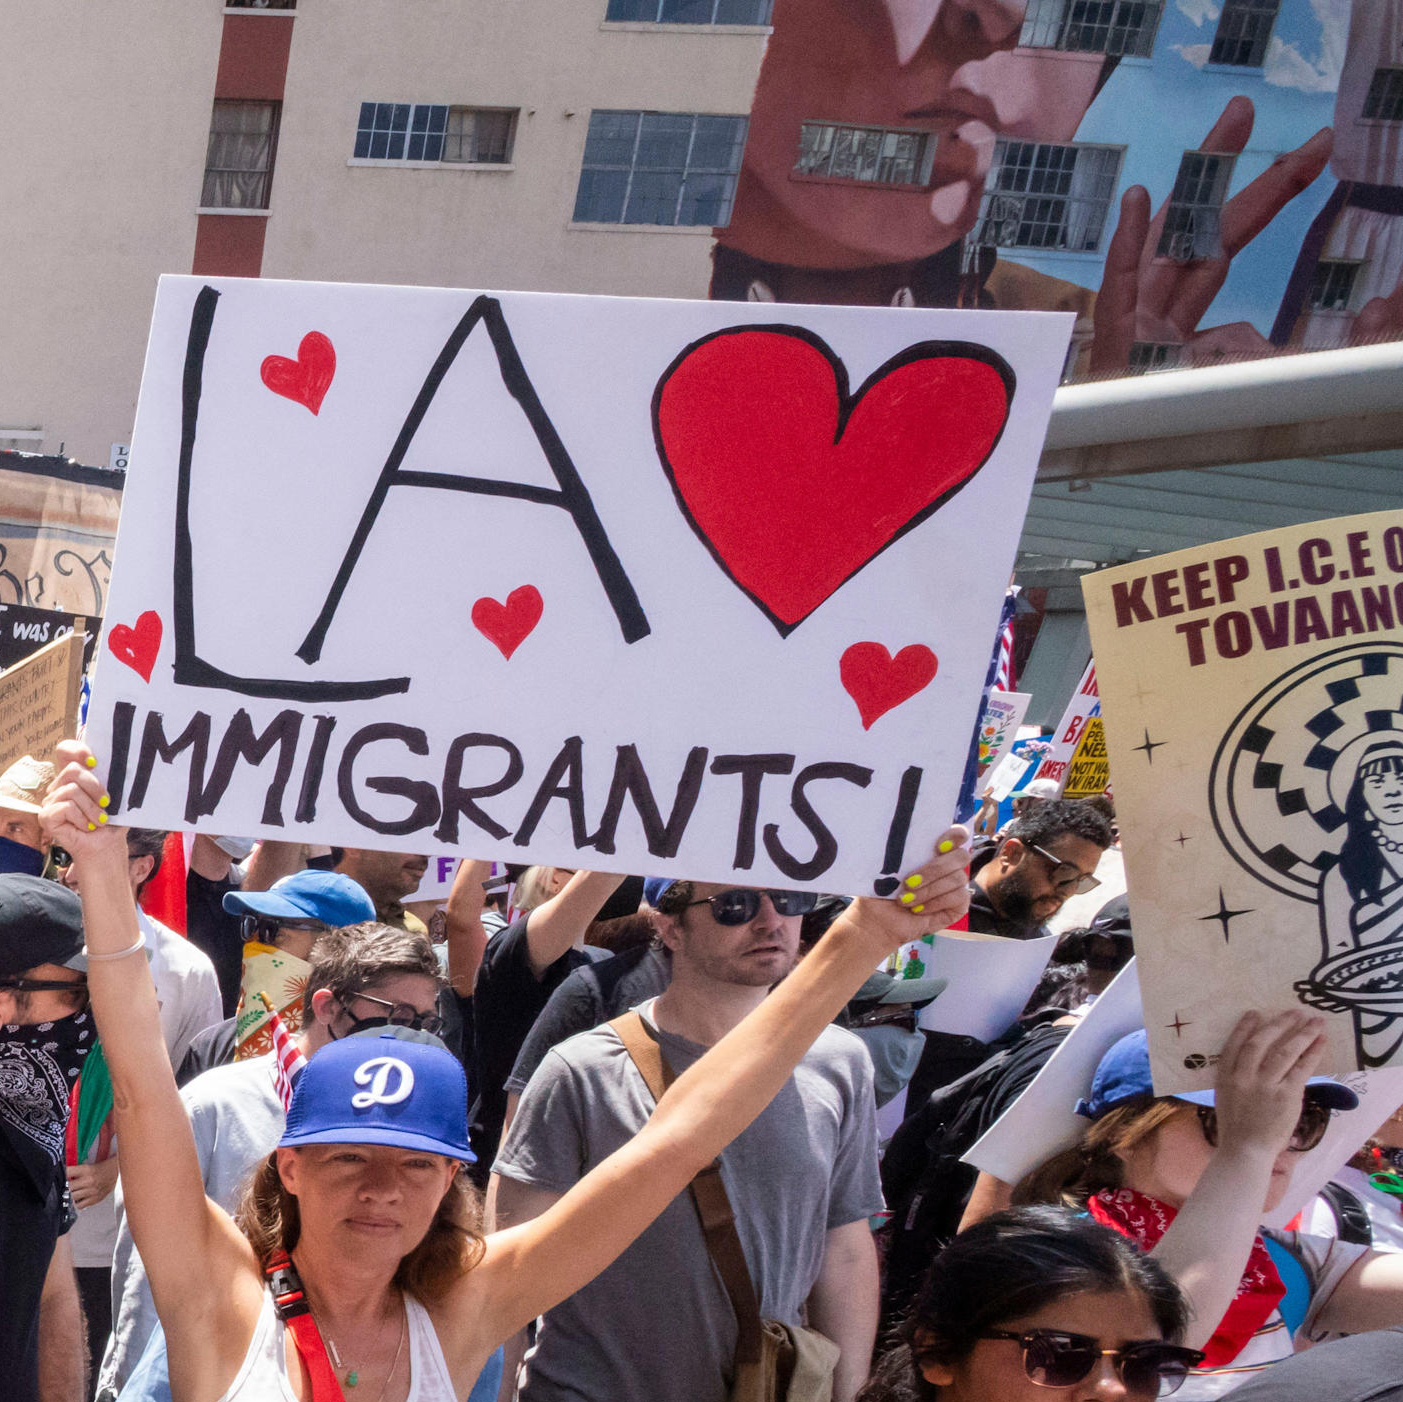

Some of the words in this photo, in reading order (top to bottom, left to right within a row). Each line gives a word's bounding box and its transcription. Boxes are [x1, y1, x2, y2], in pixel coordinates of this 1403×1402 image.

[171, 284, 652, 702] LA
[1110, 554, 1252, 628] KEEP
[1262, 530, 1376, 593] I.C.E
[13, 621, 51, 642] was
[104, 699, 924, 897] IMMIGRANTS!
[352, 1056, 415, 1110] D
